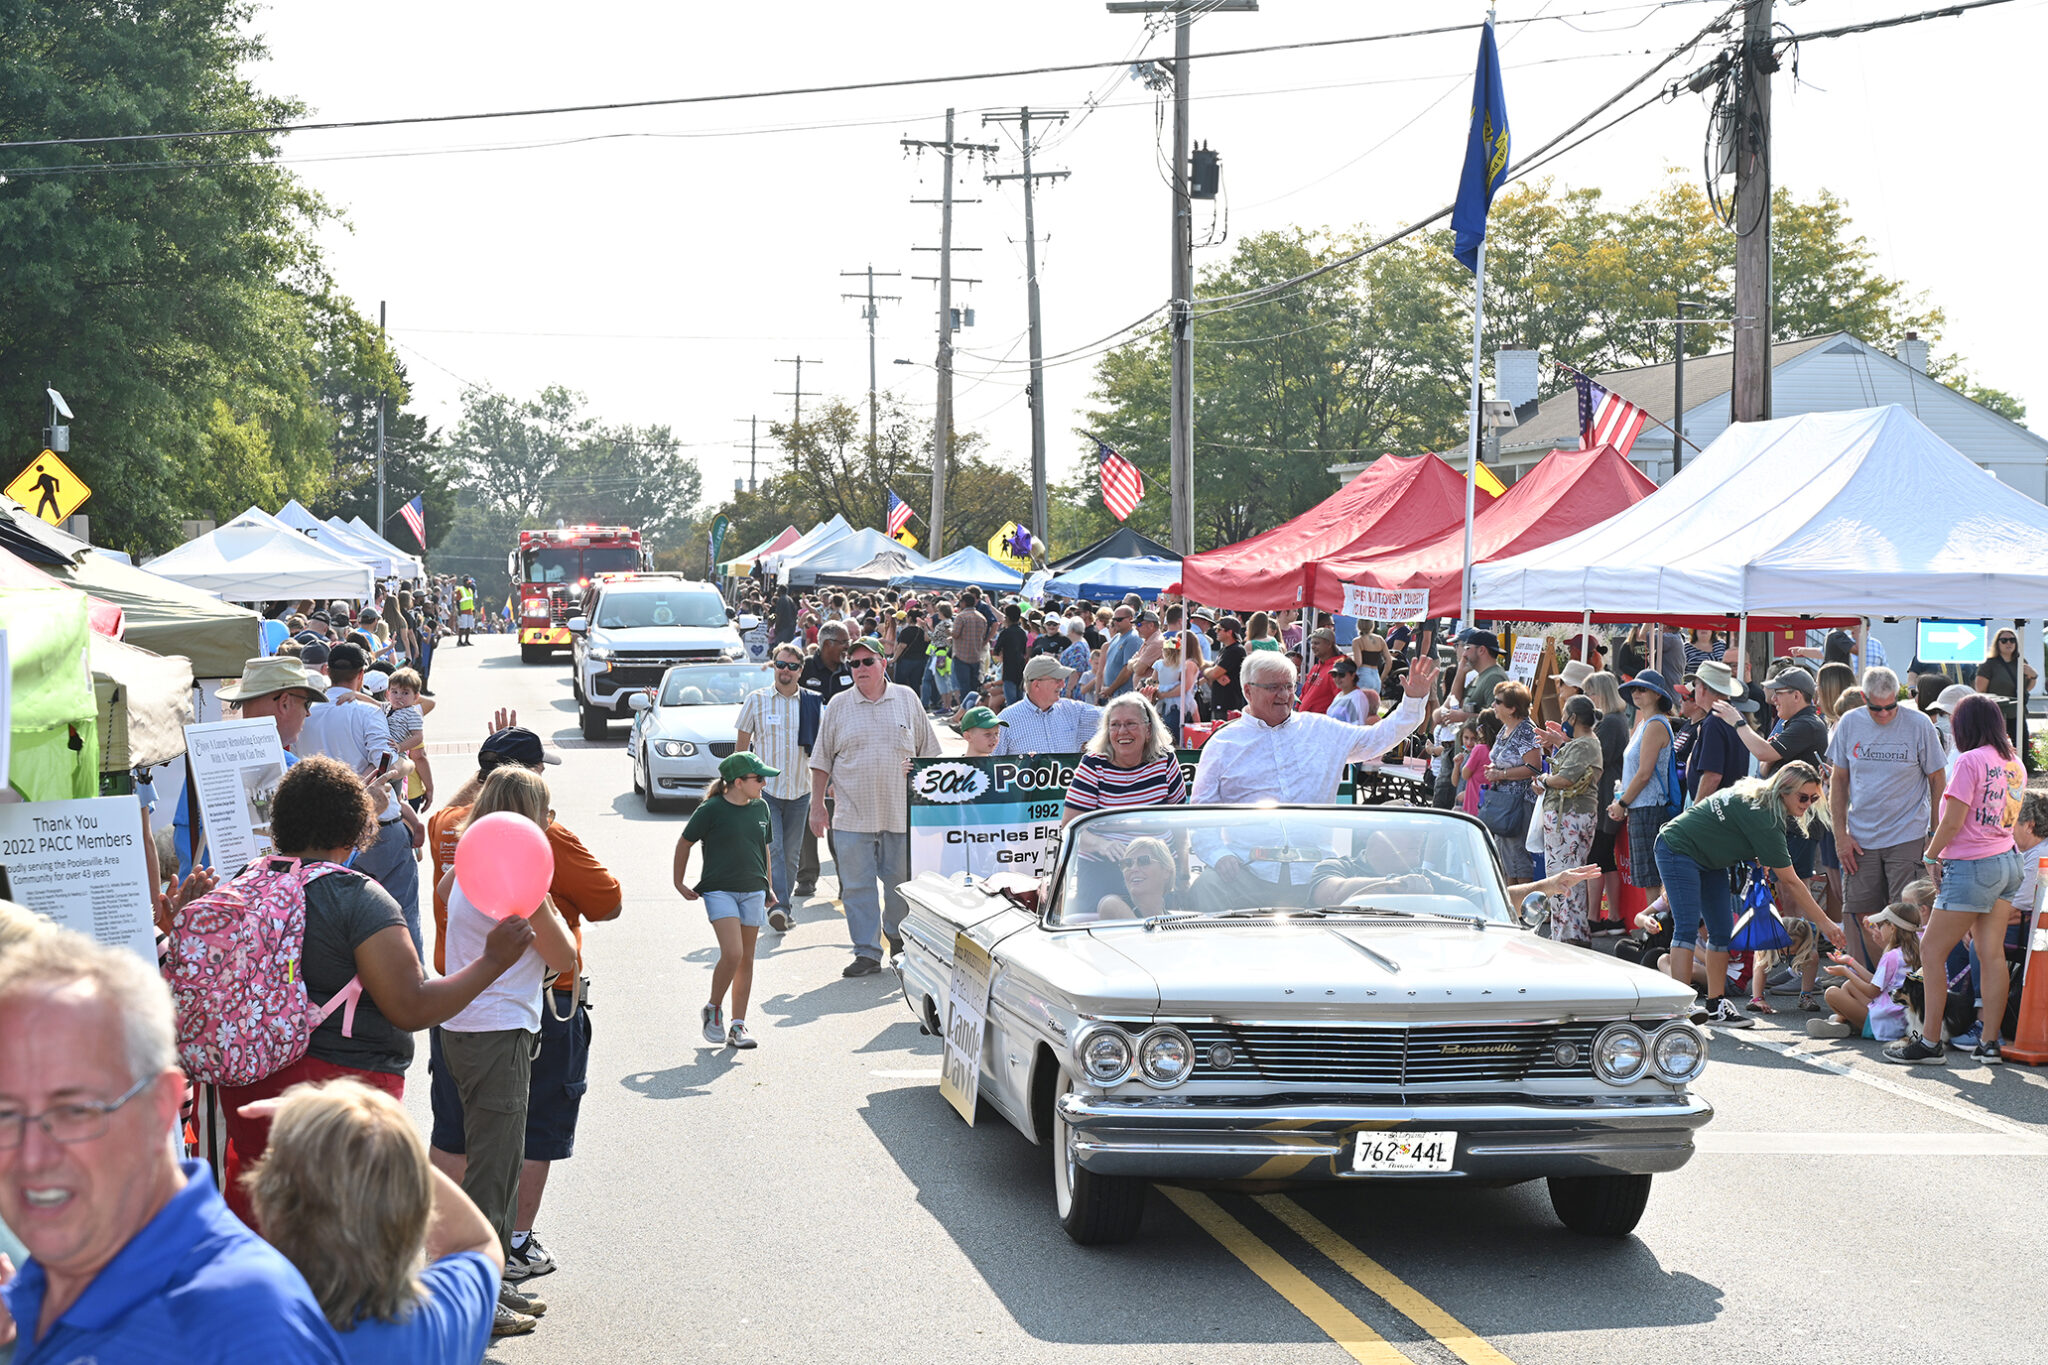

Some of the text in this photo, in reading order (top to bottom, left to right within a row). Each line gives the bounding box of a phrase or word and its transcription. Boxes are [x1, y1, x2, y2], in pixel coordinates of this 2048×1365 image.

[1859, 746, 1909, 760] Memorial
[920, 762, 1074, 795] 30th Poole
[1028, 804, 1059, 819] 1992
[32, 814, 98, 833] Thank You
[3, 833, 133, 855] 2022 PACC Members
[946, 828, 1028, 844] Charles
[996, 849, 1039, 864] Gary
[6, 856, 120, 875] oudly serving the Poolesville Area
[13, 868, 111, 885] Community for over 43 years
[1438, 1043, 1521, 1054] Bonneville
[1361, 1141, 1447, 1162] 762 44L
